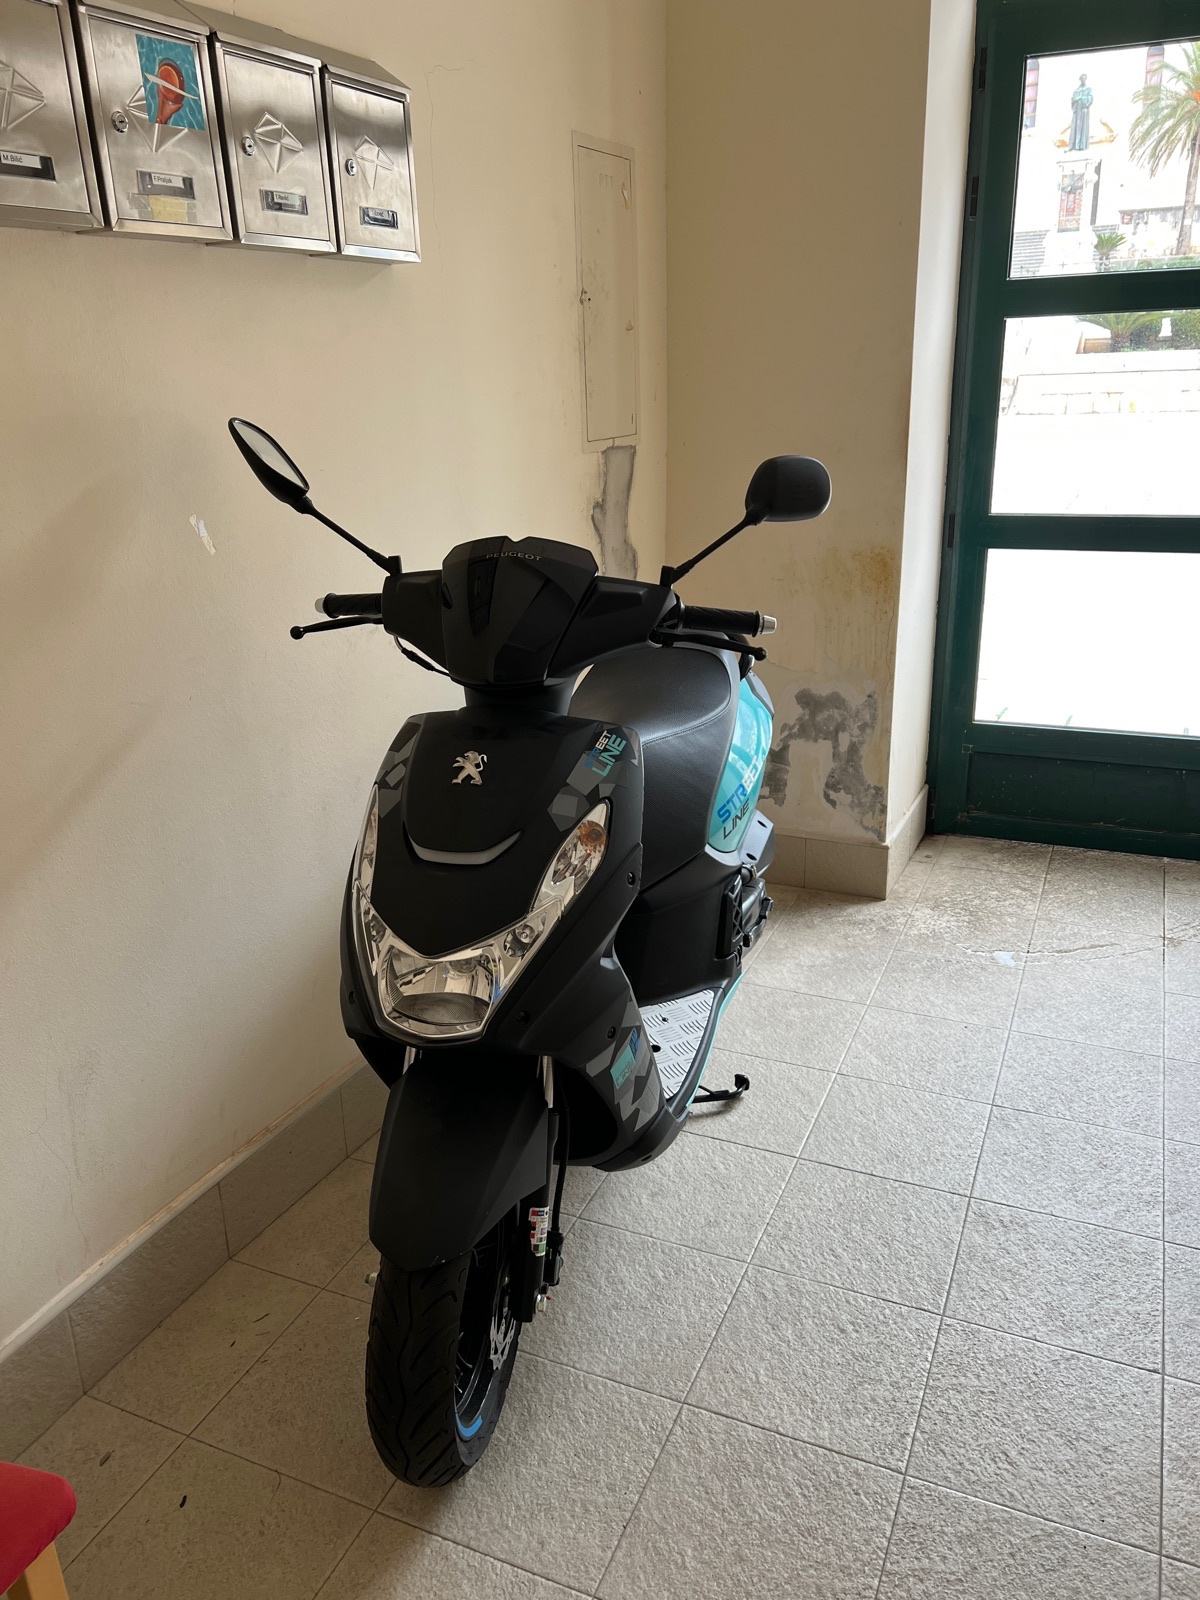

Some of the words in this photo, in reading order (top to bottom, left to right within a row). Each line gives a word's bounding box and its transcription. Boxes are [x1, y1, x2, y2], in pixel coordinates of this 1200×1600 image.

[486, 551, 543, 561] PEUGEOT
[592, 734, 627, 777] LINE
[723, 797, 750, 840] LINE
